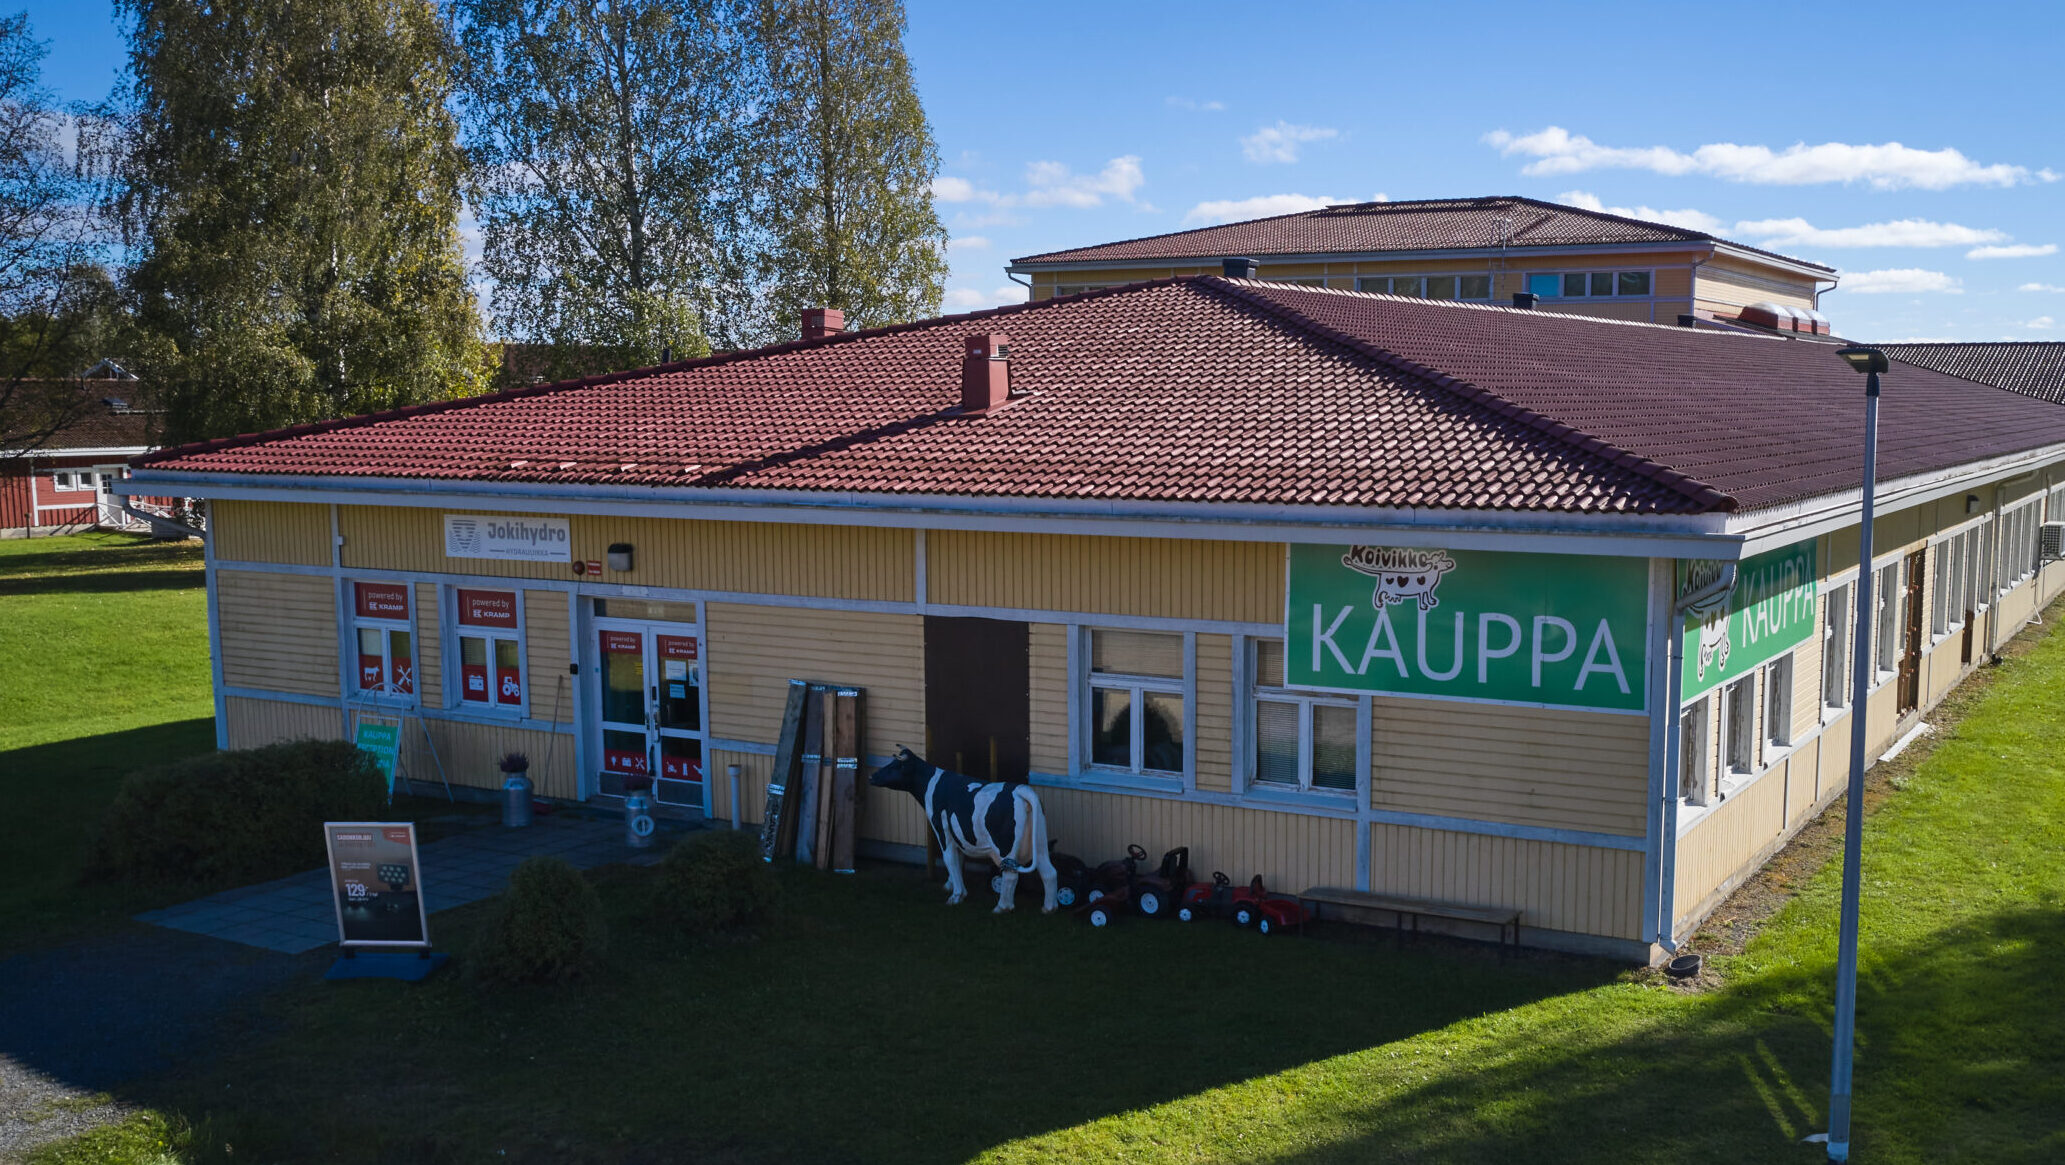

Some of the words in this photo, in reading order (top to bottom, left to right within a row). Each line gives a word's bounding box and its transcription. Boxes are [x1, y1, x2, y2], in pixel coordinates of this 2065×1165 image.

[487, 522, 566, 546] Jokihydro
[1351, 545, 1429, 569] Koivikko
[368, 591, 394, 601] powered
[395, 593, 403, 601] by
[472, 598, 501, 608] powered
[502, 600, 510, 609] by
[1743, 552, 1814, 648] KAUPPA
[483, 611, 510, 619] KRAMP
[1312, 603, 1632, 694] KAUPPA
[363, 730, 391, 741] KAUPPA
